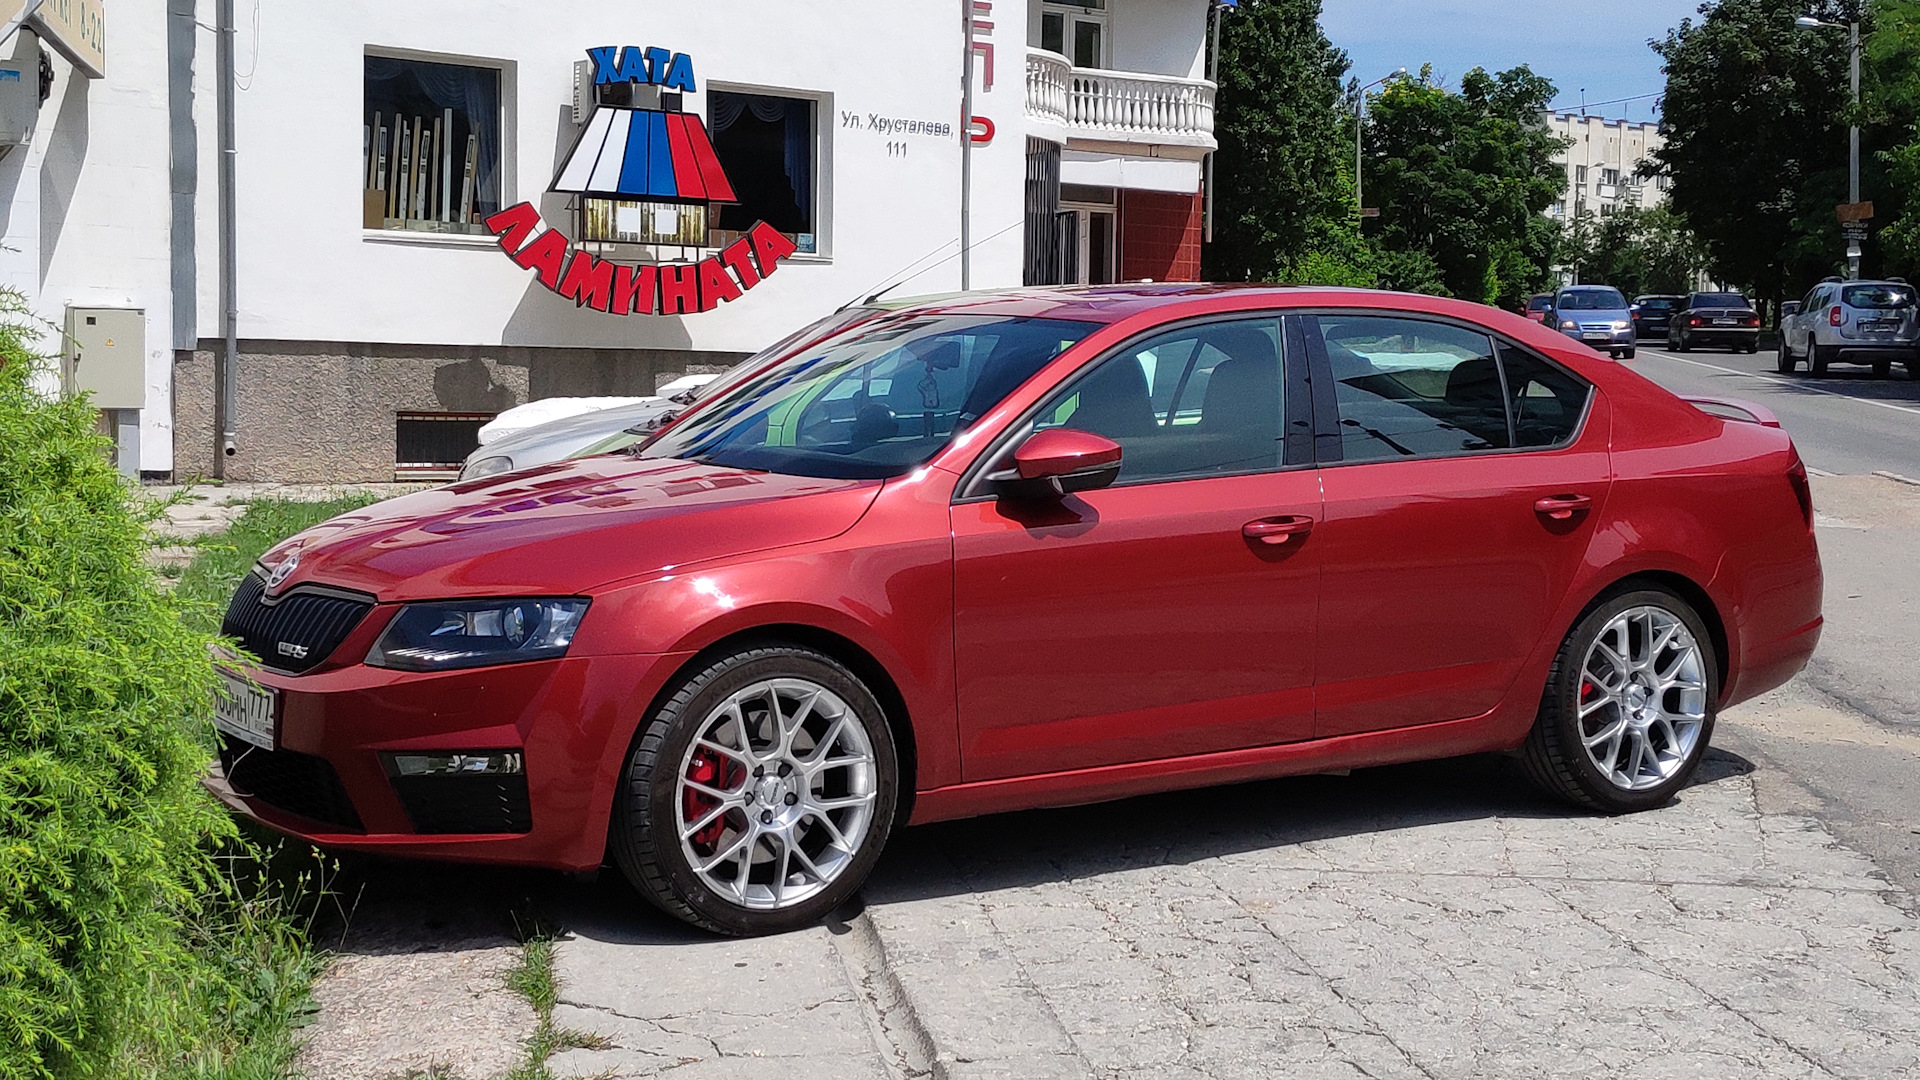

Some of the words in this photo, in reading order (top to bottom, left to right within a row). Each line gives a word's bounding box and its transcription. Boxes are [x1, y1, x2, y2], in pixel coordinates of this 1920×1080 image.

[81, 1, 101, 54] 8-22
[586, 46, 696, 92] ХАТА
[841, 110, 863, 129] Ул.
[867, 113, 954, 139] Хрусталева,
[886, 141, 907, 158] 111
[484, 201, 798, 315] ЛАМИНАТА
[249, 690, 270, 721] 777
